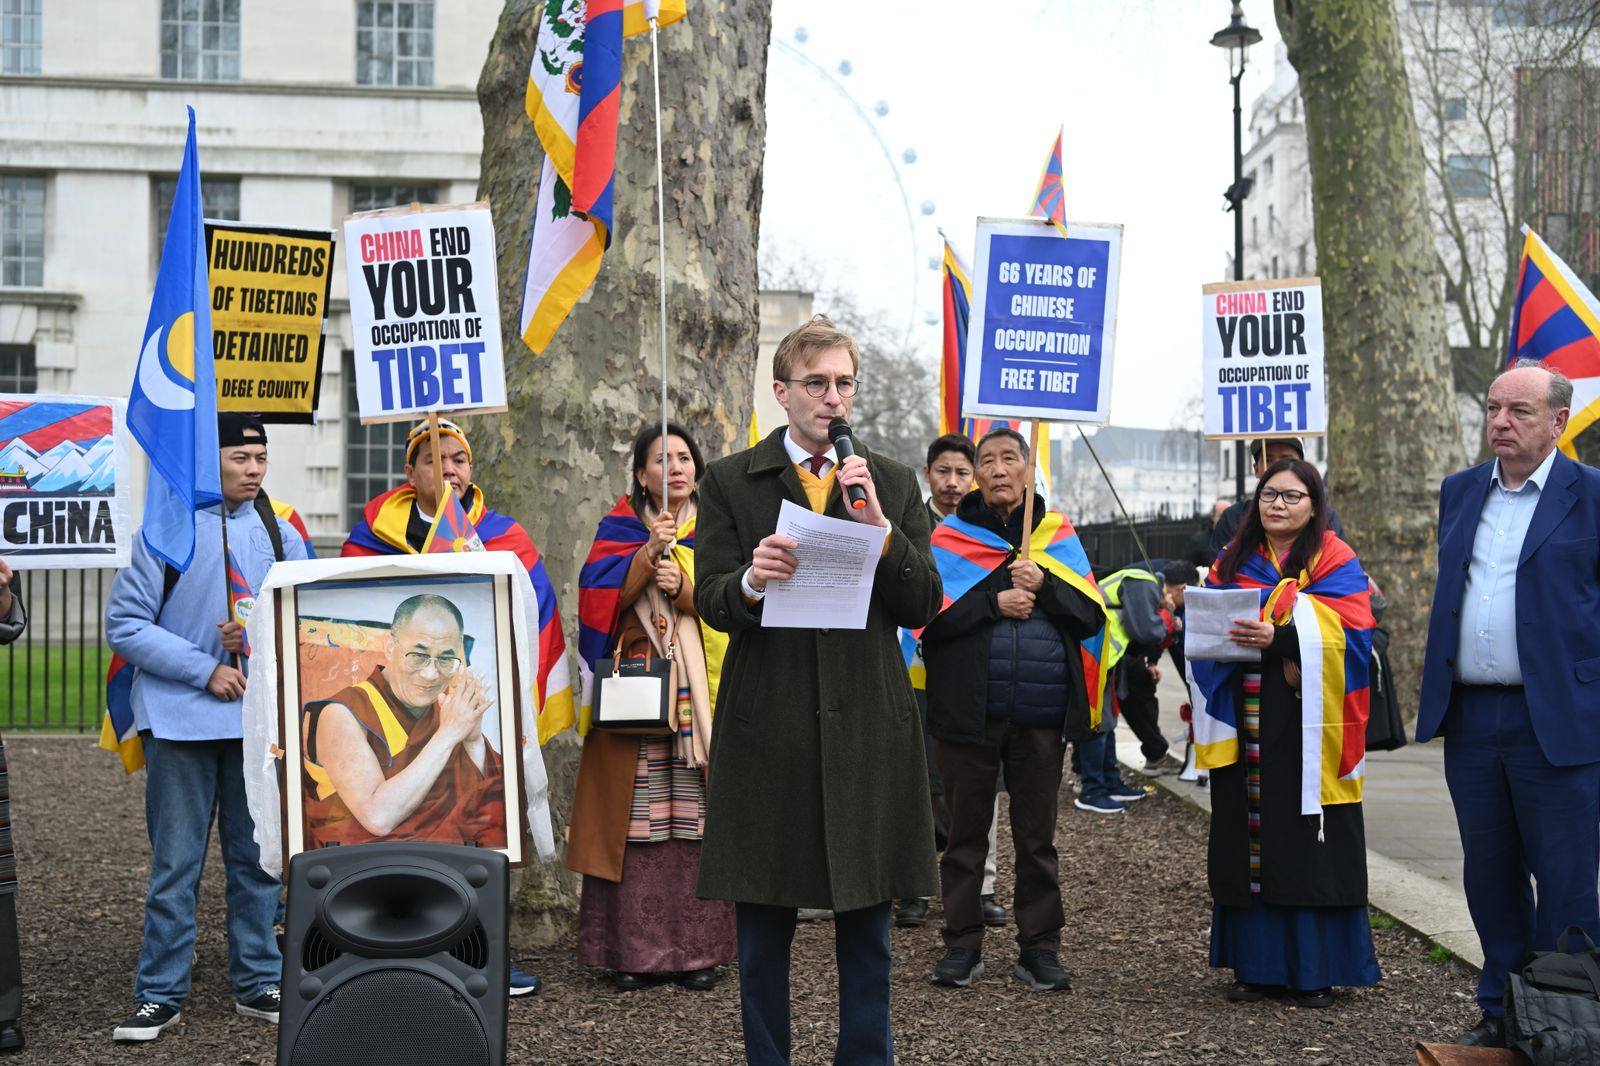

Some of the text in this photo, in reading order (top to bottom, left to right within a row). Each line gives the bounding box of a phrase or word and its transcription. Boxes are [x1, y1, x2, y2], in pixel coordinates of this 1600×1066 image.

[213, 239, 326, 278] HUNDREDS
[360, 226, 471, 263] CHINA END
[361, 257, 477, 321] YOUR
[999, 262, 1097, 289] 66 YEARS OF
[212, 285, 318, 317] OF TIBETANS
[1011, 294, 1075, 319] CHINESE
[1216, 290, 1305, 315] CHINA END
[213, 330, 309, 363] DETAINED
[371, 317, 482, 346] OCCUPATION OF
[994, 328, 1091, 356] OCCUPATION
[1216, 313, 1307, 359] YOUR
[221, 378, 254, 398] DEGE
[257, 379, 310, 399] COUNTY
[371, 341, 486, 411] TIBET
[1000, 368, 1080, 394] FREE TIBET
[1218, 364, 1310, 383] OCCUPATION OF
[1217, 383, 1312, 433] TIBET
